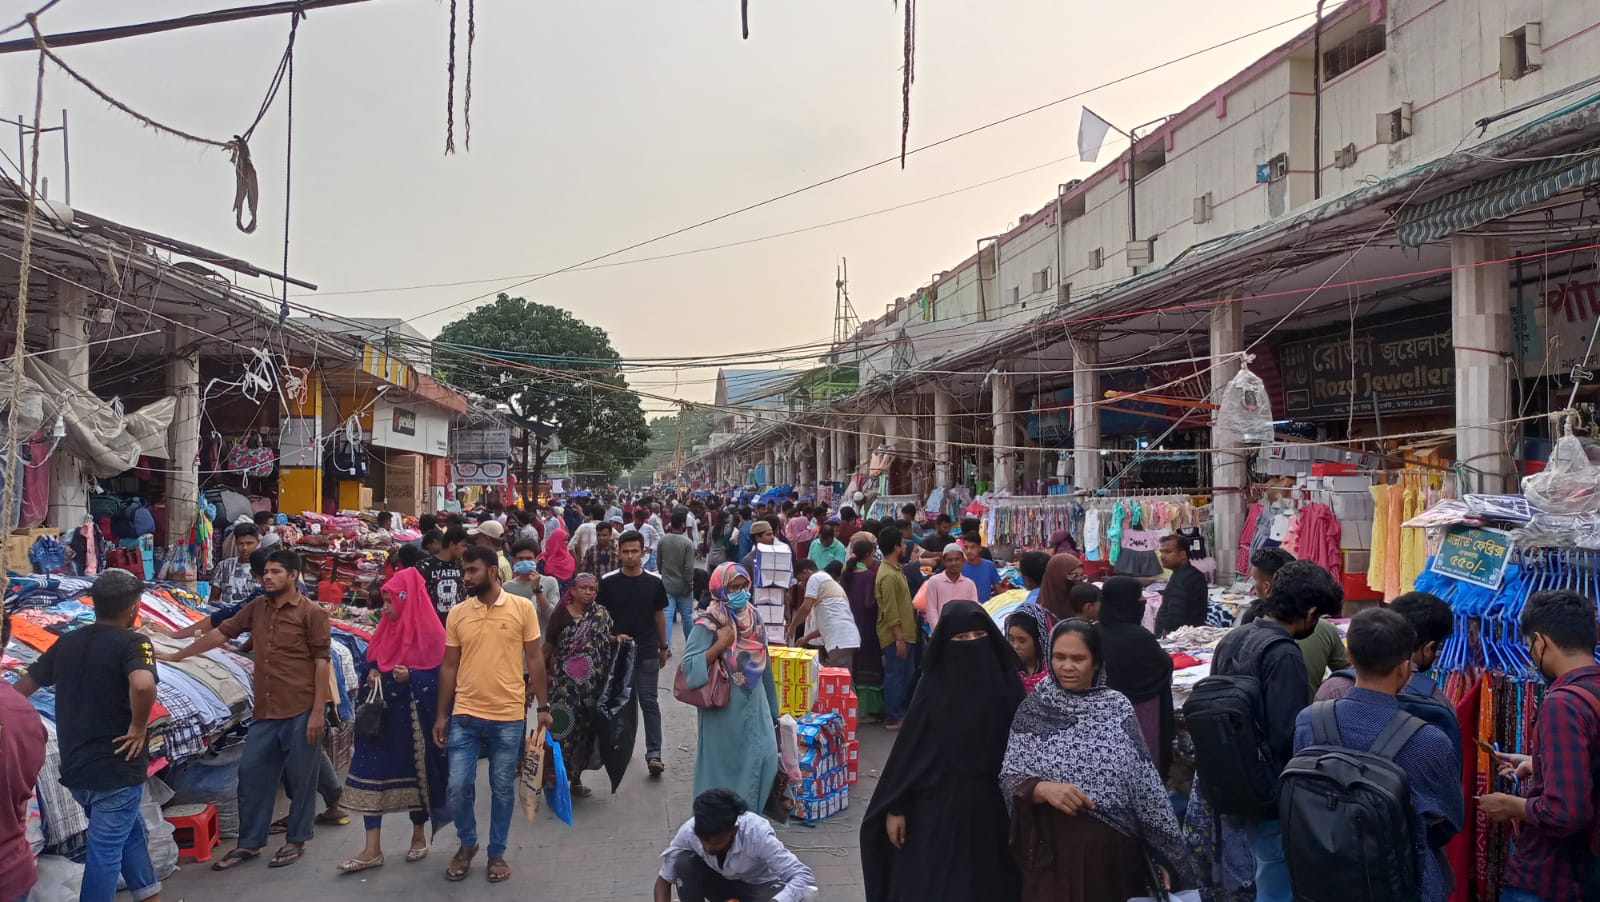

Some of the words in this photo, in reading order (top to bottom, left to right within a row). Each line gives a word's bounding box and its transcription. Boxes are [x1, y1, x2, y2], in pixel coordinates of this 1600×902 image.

[1313, 334, 1375, 373] রোজা
[1314, 377, 1356, 399] Roza
[1363, 364, 1455, 398] Jeweller
